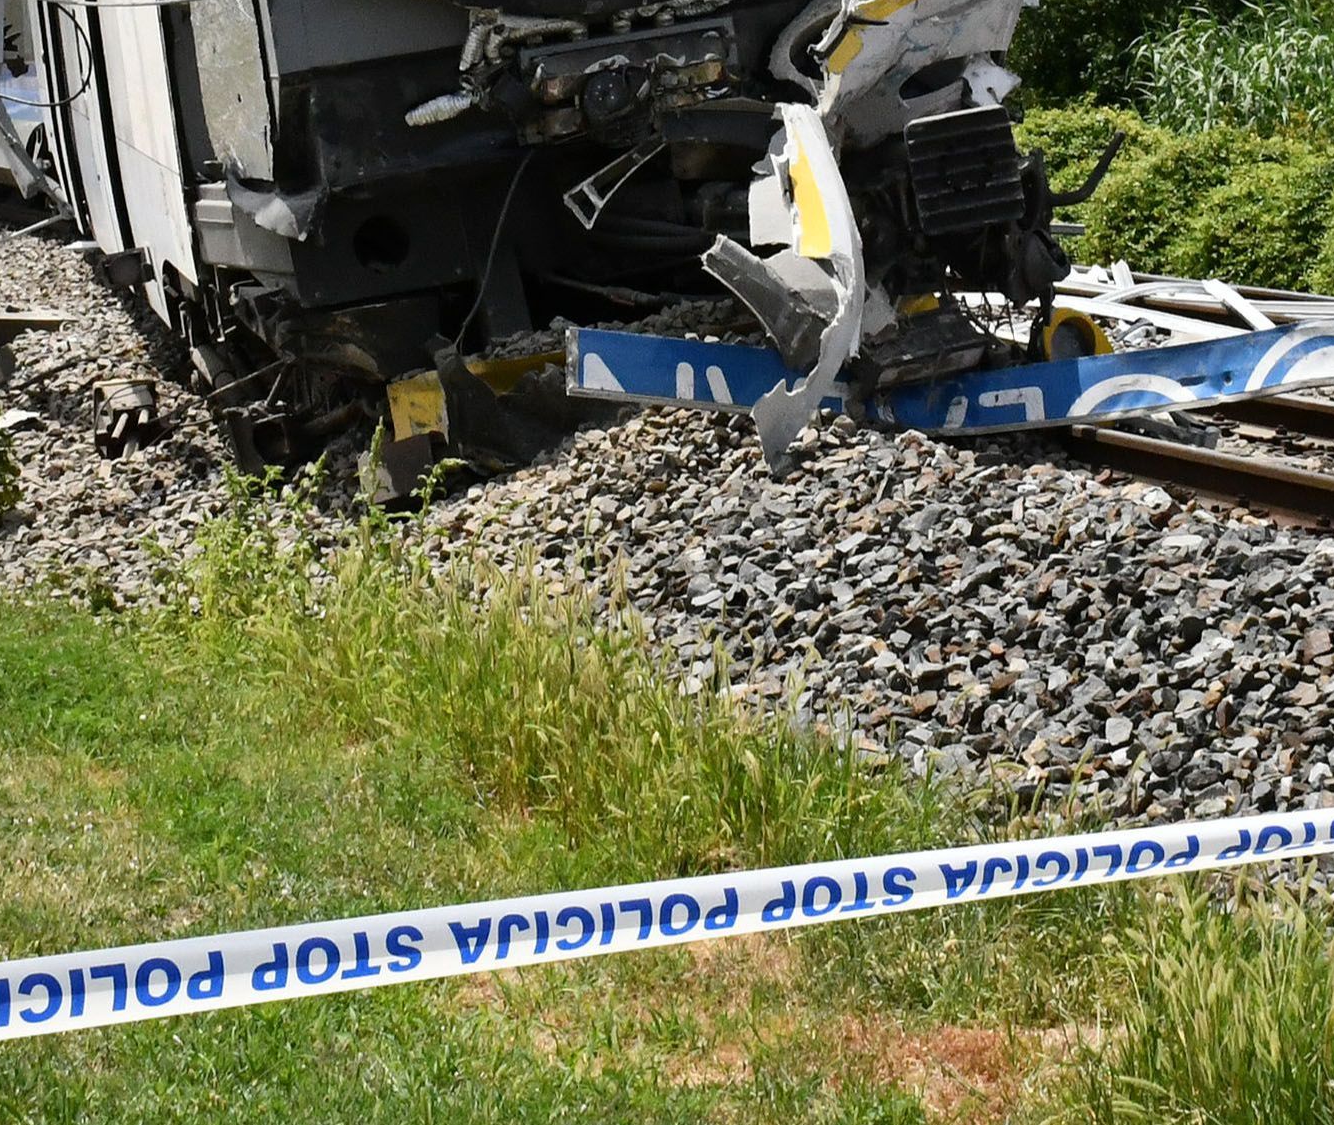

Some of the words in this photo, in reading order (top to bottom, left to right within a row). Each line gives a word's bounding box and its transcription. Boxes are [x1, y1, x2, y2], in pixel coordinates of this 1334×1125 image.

[761, 866, 918, 924] STOP
[939, 834, 1201, 899] POLICIJA
[251, 925, 425, 992] STOP
[447, 887, 740, 965] POLICIJA
